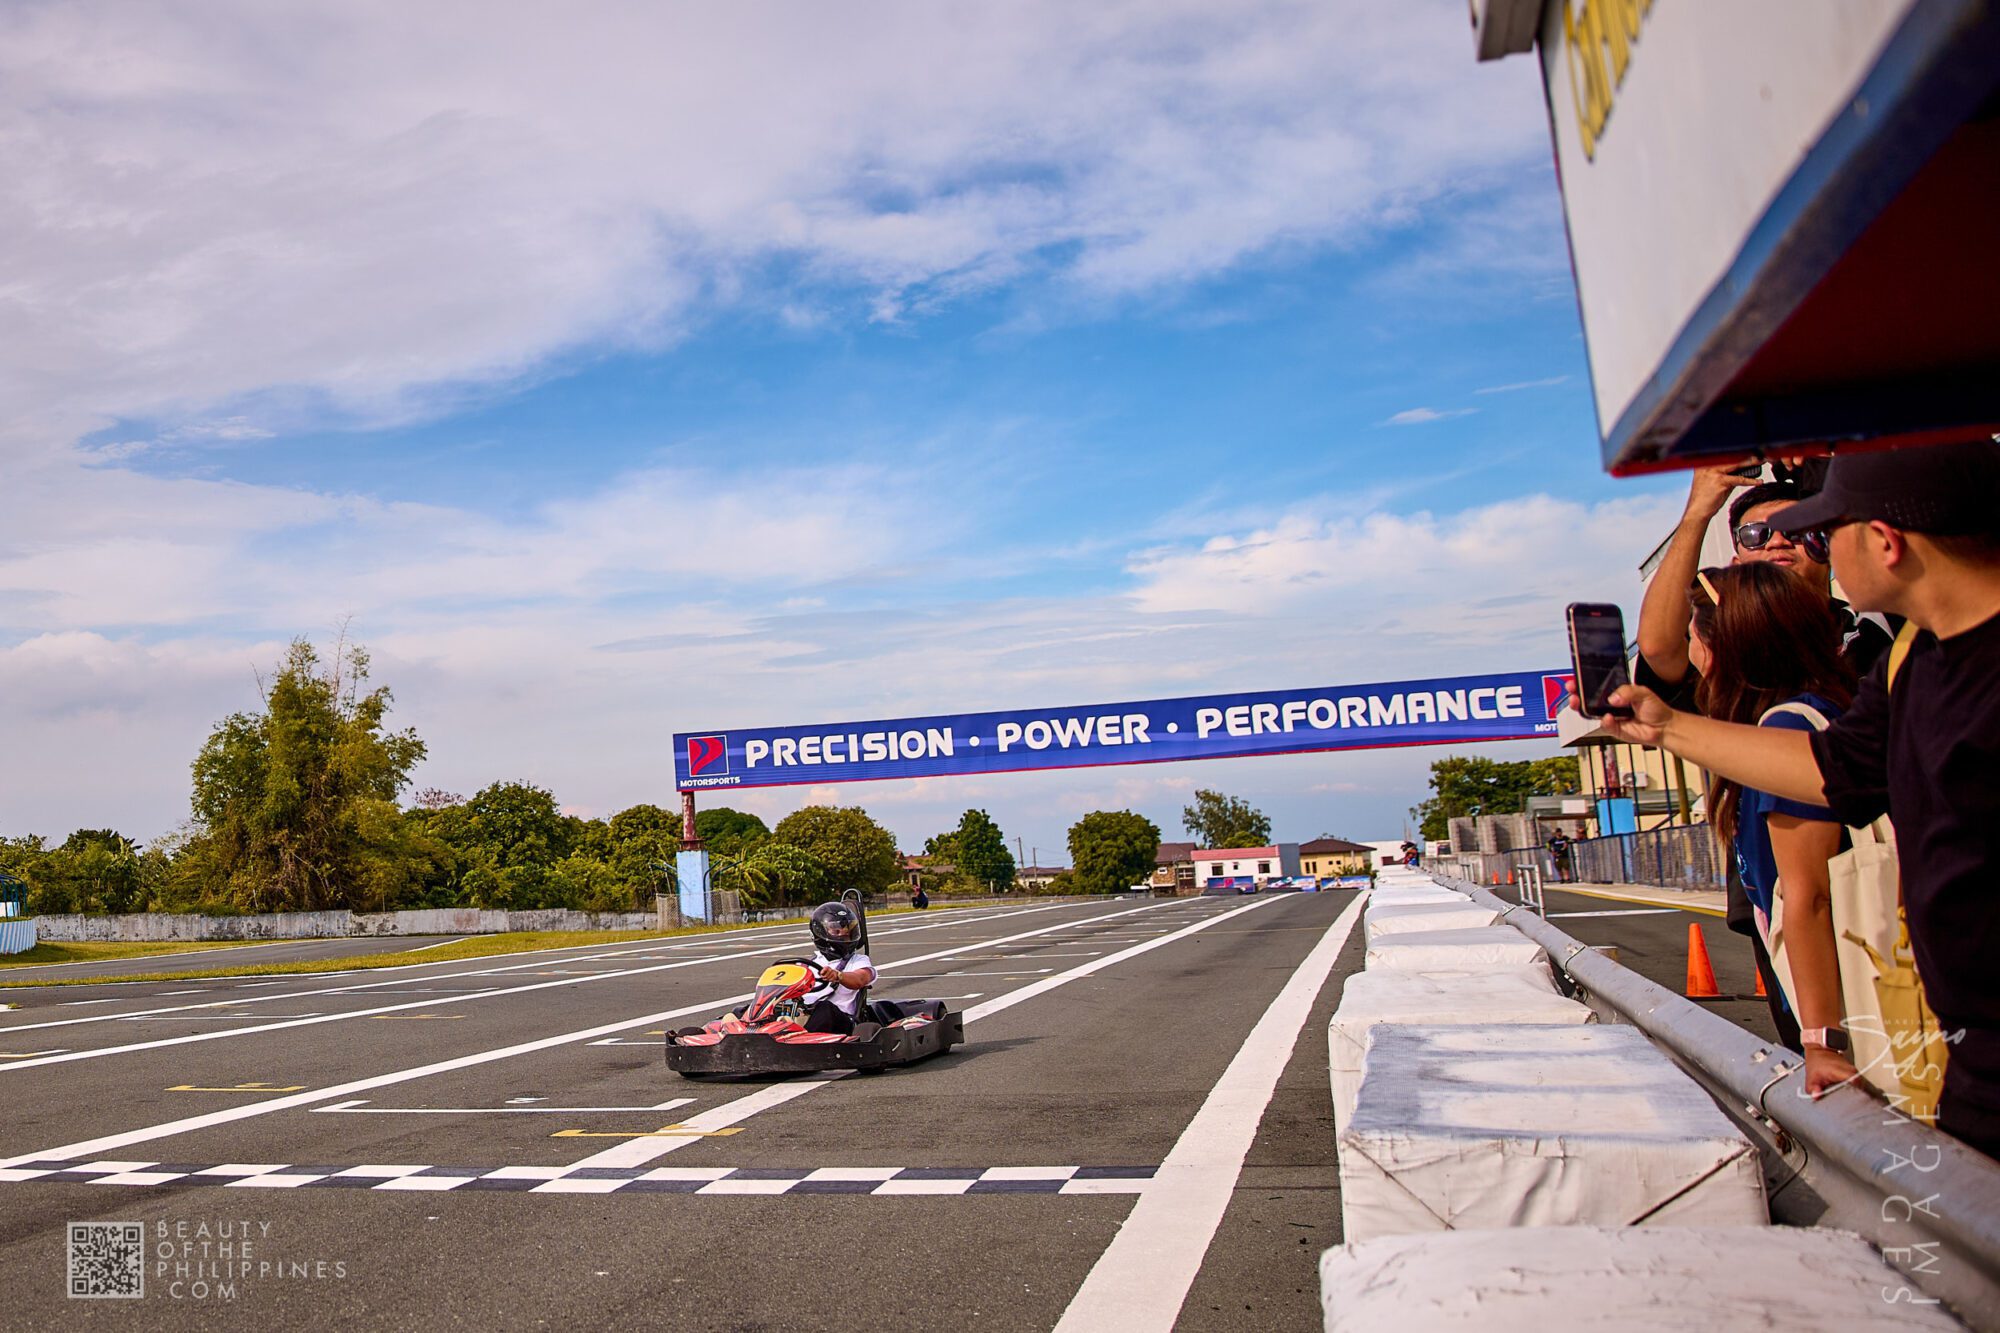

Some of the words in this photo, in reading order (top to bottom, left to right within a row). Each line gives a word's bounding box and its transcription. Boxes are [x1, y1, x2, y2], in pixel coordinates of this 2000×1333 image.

[745, 727, 953, 768] PRECISION
[996, 713, 1151, 753] POWER
[1195, 685, 1525, 739] PERFORMANCE
[680, 776, 741, 788] MOTORSPORTS
[772, 971, 786, 981] 2
